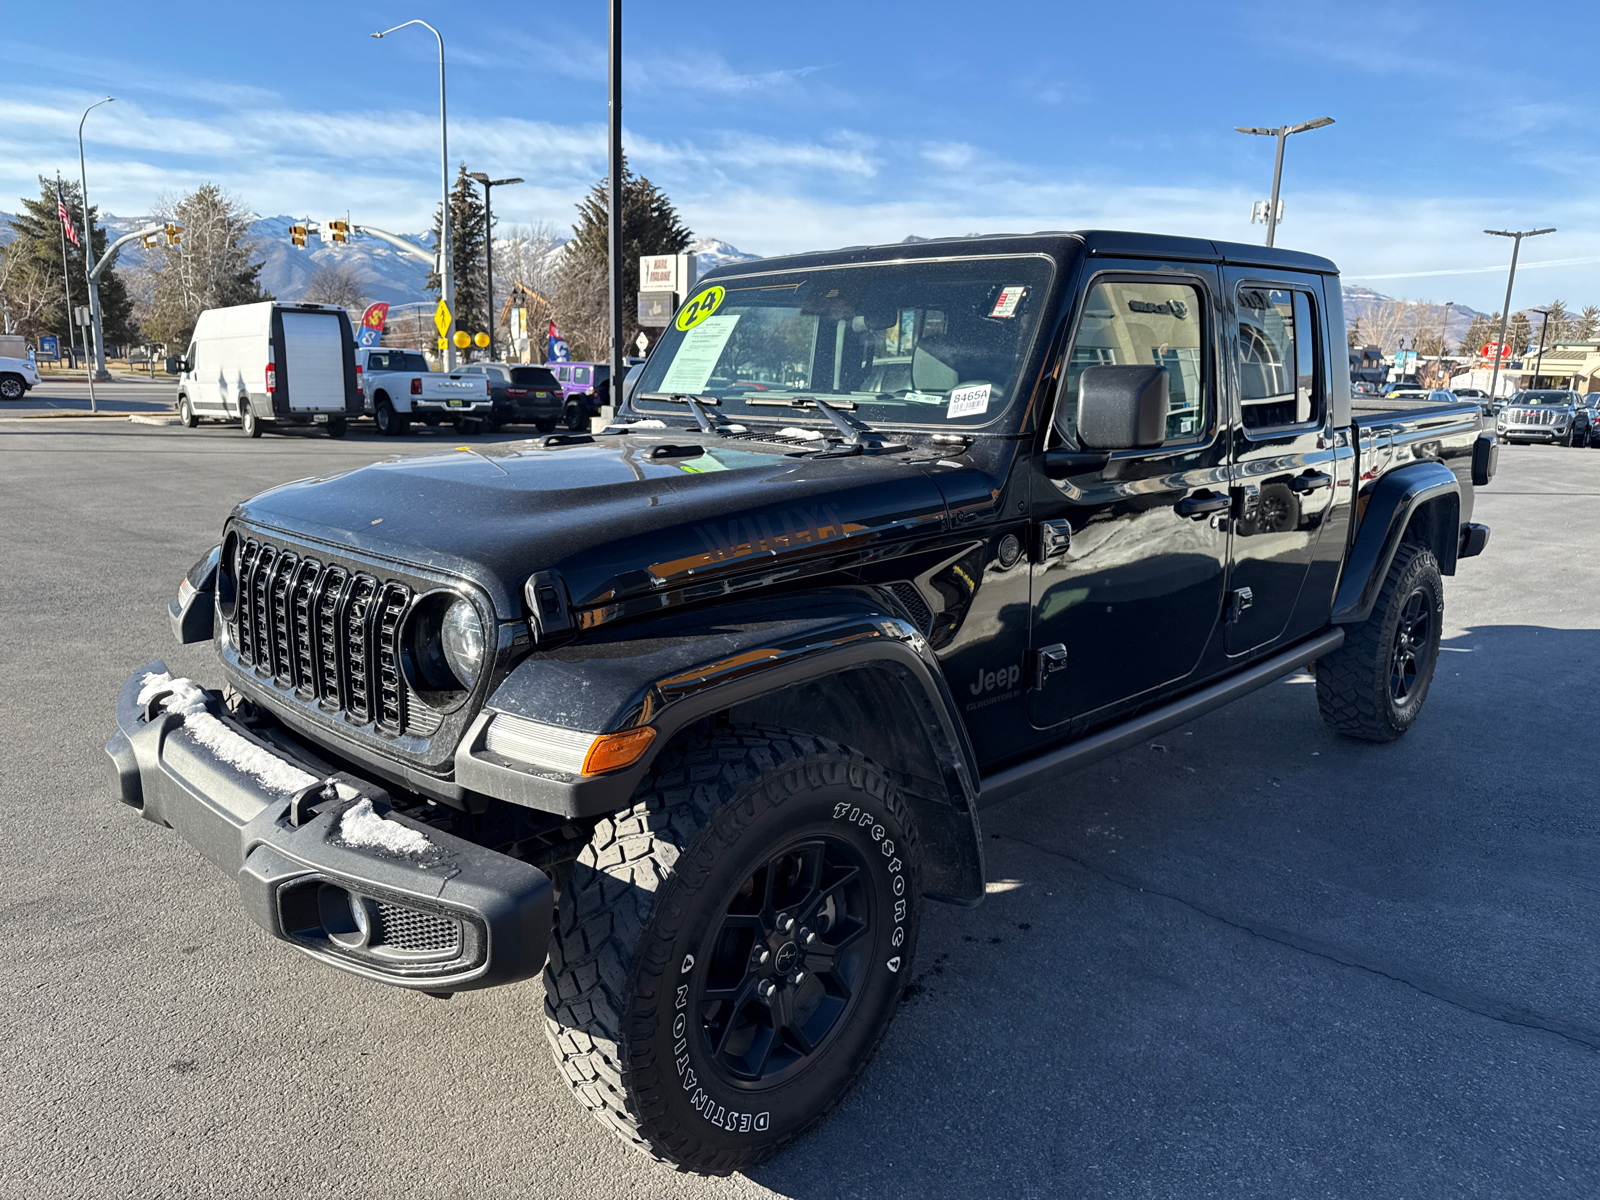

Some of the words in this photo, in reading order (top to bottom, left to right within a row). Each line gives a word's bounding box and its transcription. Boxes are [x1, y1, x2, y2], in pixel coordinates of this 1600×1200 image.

[685, 291, 717, 327] 24
[953, 389, 988, 404] 8465A
[692, 502, 844, 561] WILLYS
[969, 664, 1020, 695] Jeep
[966, 692, 1012, 712] GLADIATOR
[832, 801, 907, 948] Firestone
[672, 983, 770, 1133] DESTINATION
